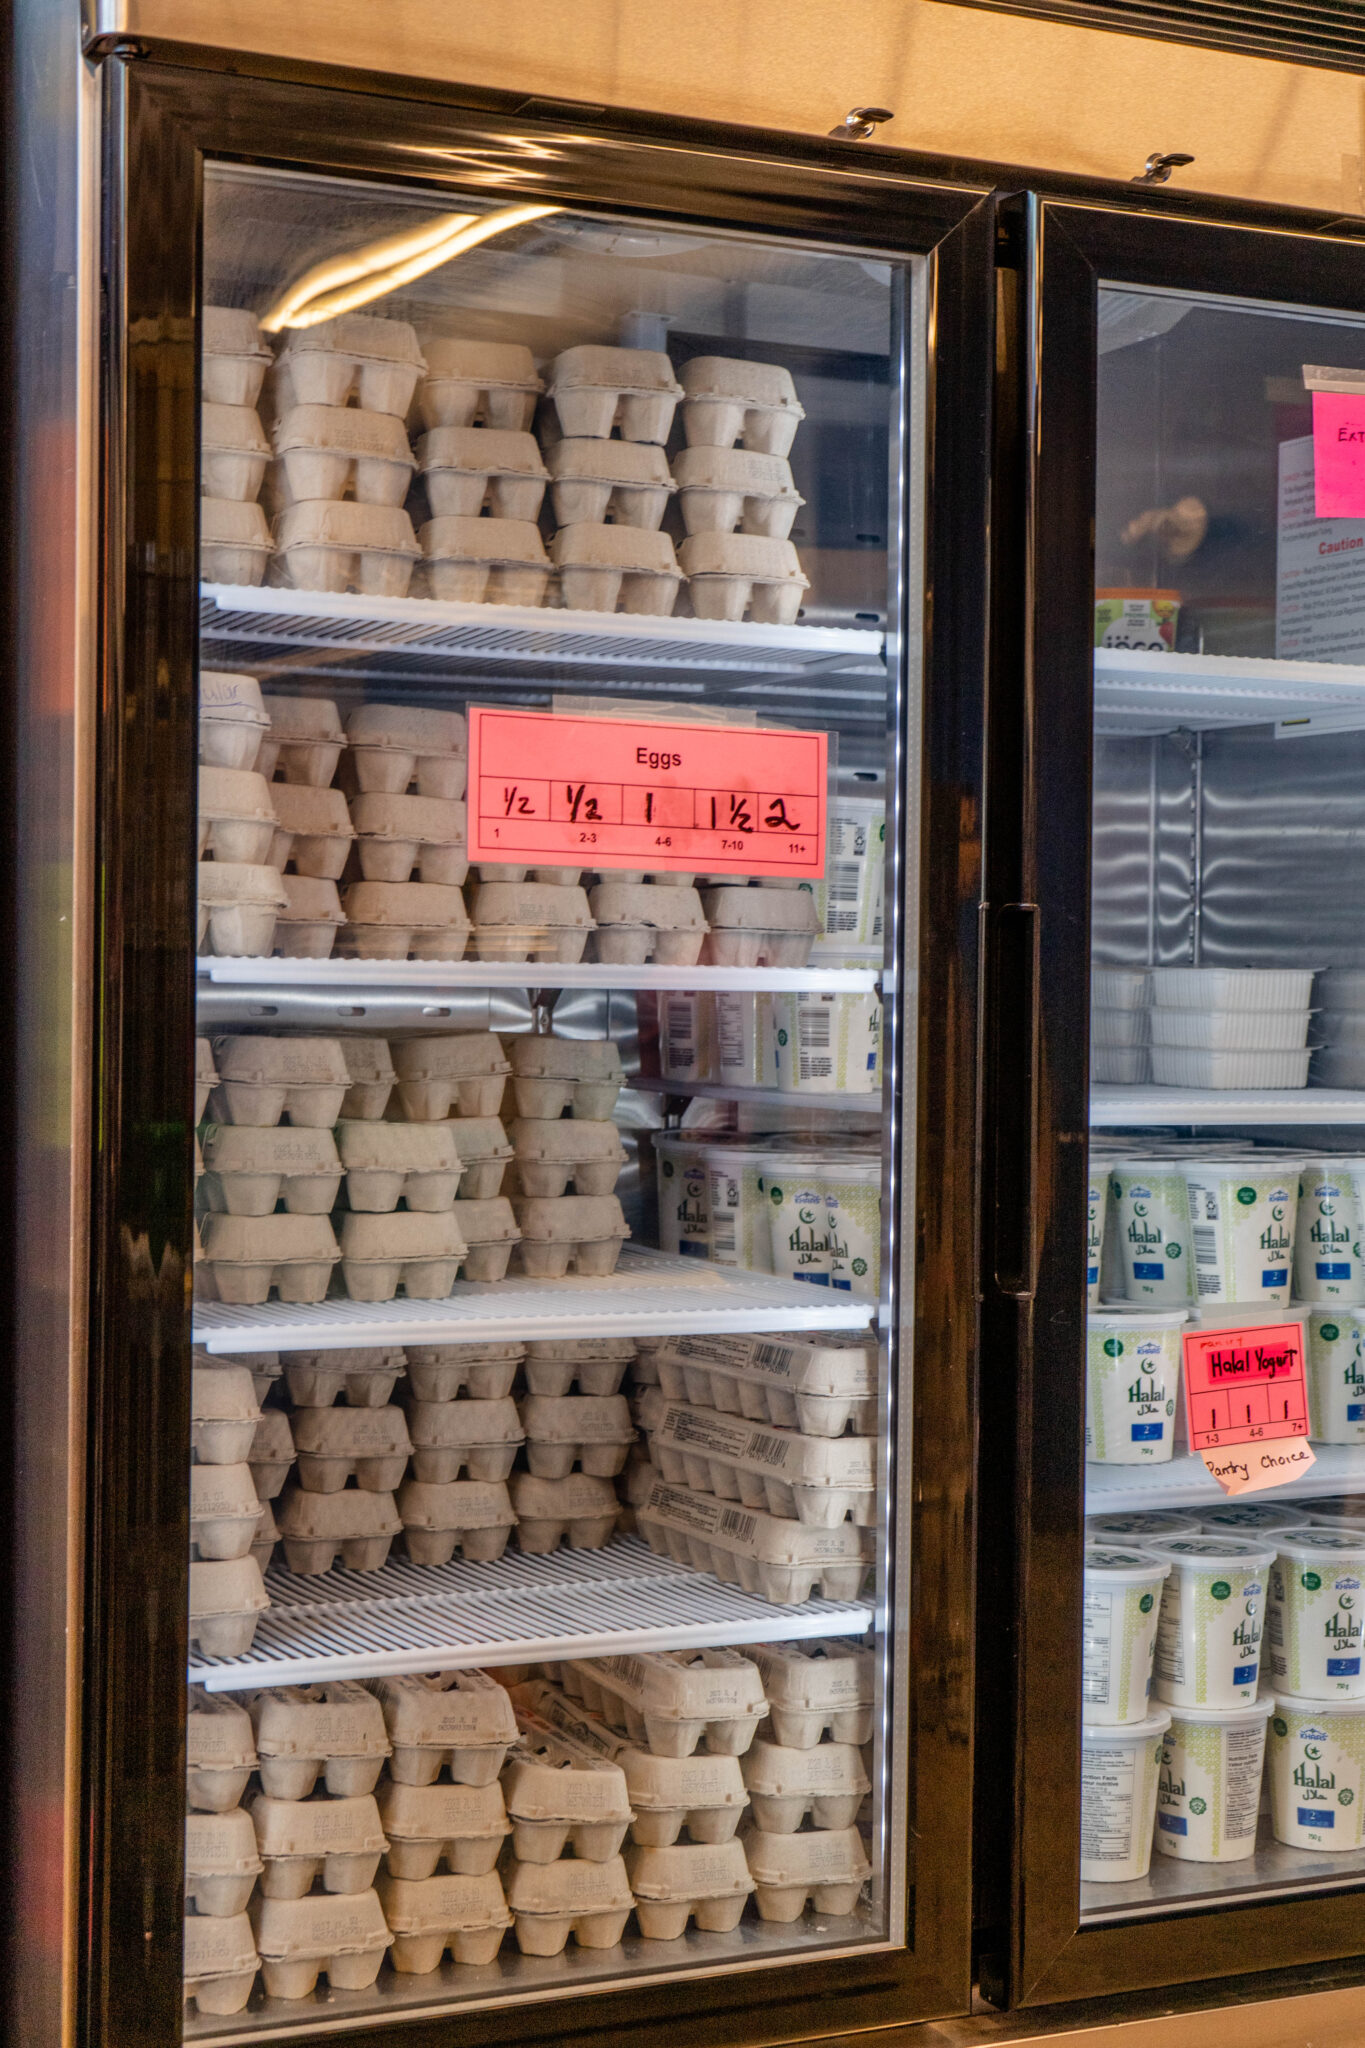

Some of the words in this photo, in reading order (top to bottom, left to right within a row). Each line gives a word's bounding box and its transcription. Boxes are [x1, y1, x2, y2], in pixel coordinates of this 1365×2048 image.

[1318, 537, 1364, 555] Caution
[636, 747, 682, 769] Eggs
[646, 792, 654, 824] 1
[765, 798, 800, 831] 2
[579, 832, 597, 844] 2-3
[655, 836, 672, 848] 4-6
[721, 839, 744, 851] 7-10
[789, 842, 806, 854] 11+
[677, 1198, 708, 1223] Hala
[788, 1225, 829, 1252] Halal
[1128, 1218, 1163, 1244] Halal
[1260, 1223, 1291, 1250] Halal
[1310, 1217, 1350, 1243] Halal
[1127, 1376, 1165, 1403] Halal
[1211, 1408, 1217, 1430] 1
[1246, 1404, 1251, 1424] 1
[1284, 1400, 1289, 1420] 1
[1205, 1435, 1220, 1445] 1-3
[1249, 1427, 1264, 1438] 4-6
[1292, 1422, 1303, 1432] 7+
[1206, 1460, 1250, 1481] Pantry
[1261, 1450, 1310, 1468] Choice
[1233, 1618, 1261, 1646] Halal
[1324, 1611, 1363, 1638] Halal
[1159, 1768, 1186, 1797] alal
[1292, 1761, 1336, 1790] Halal
